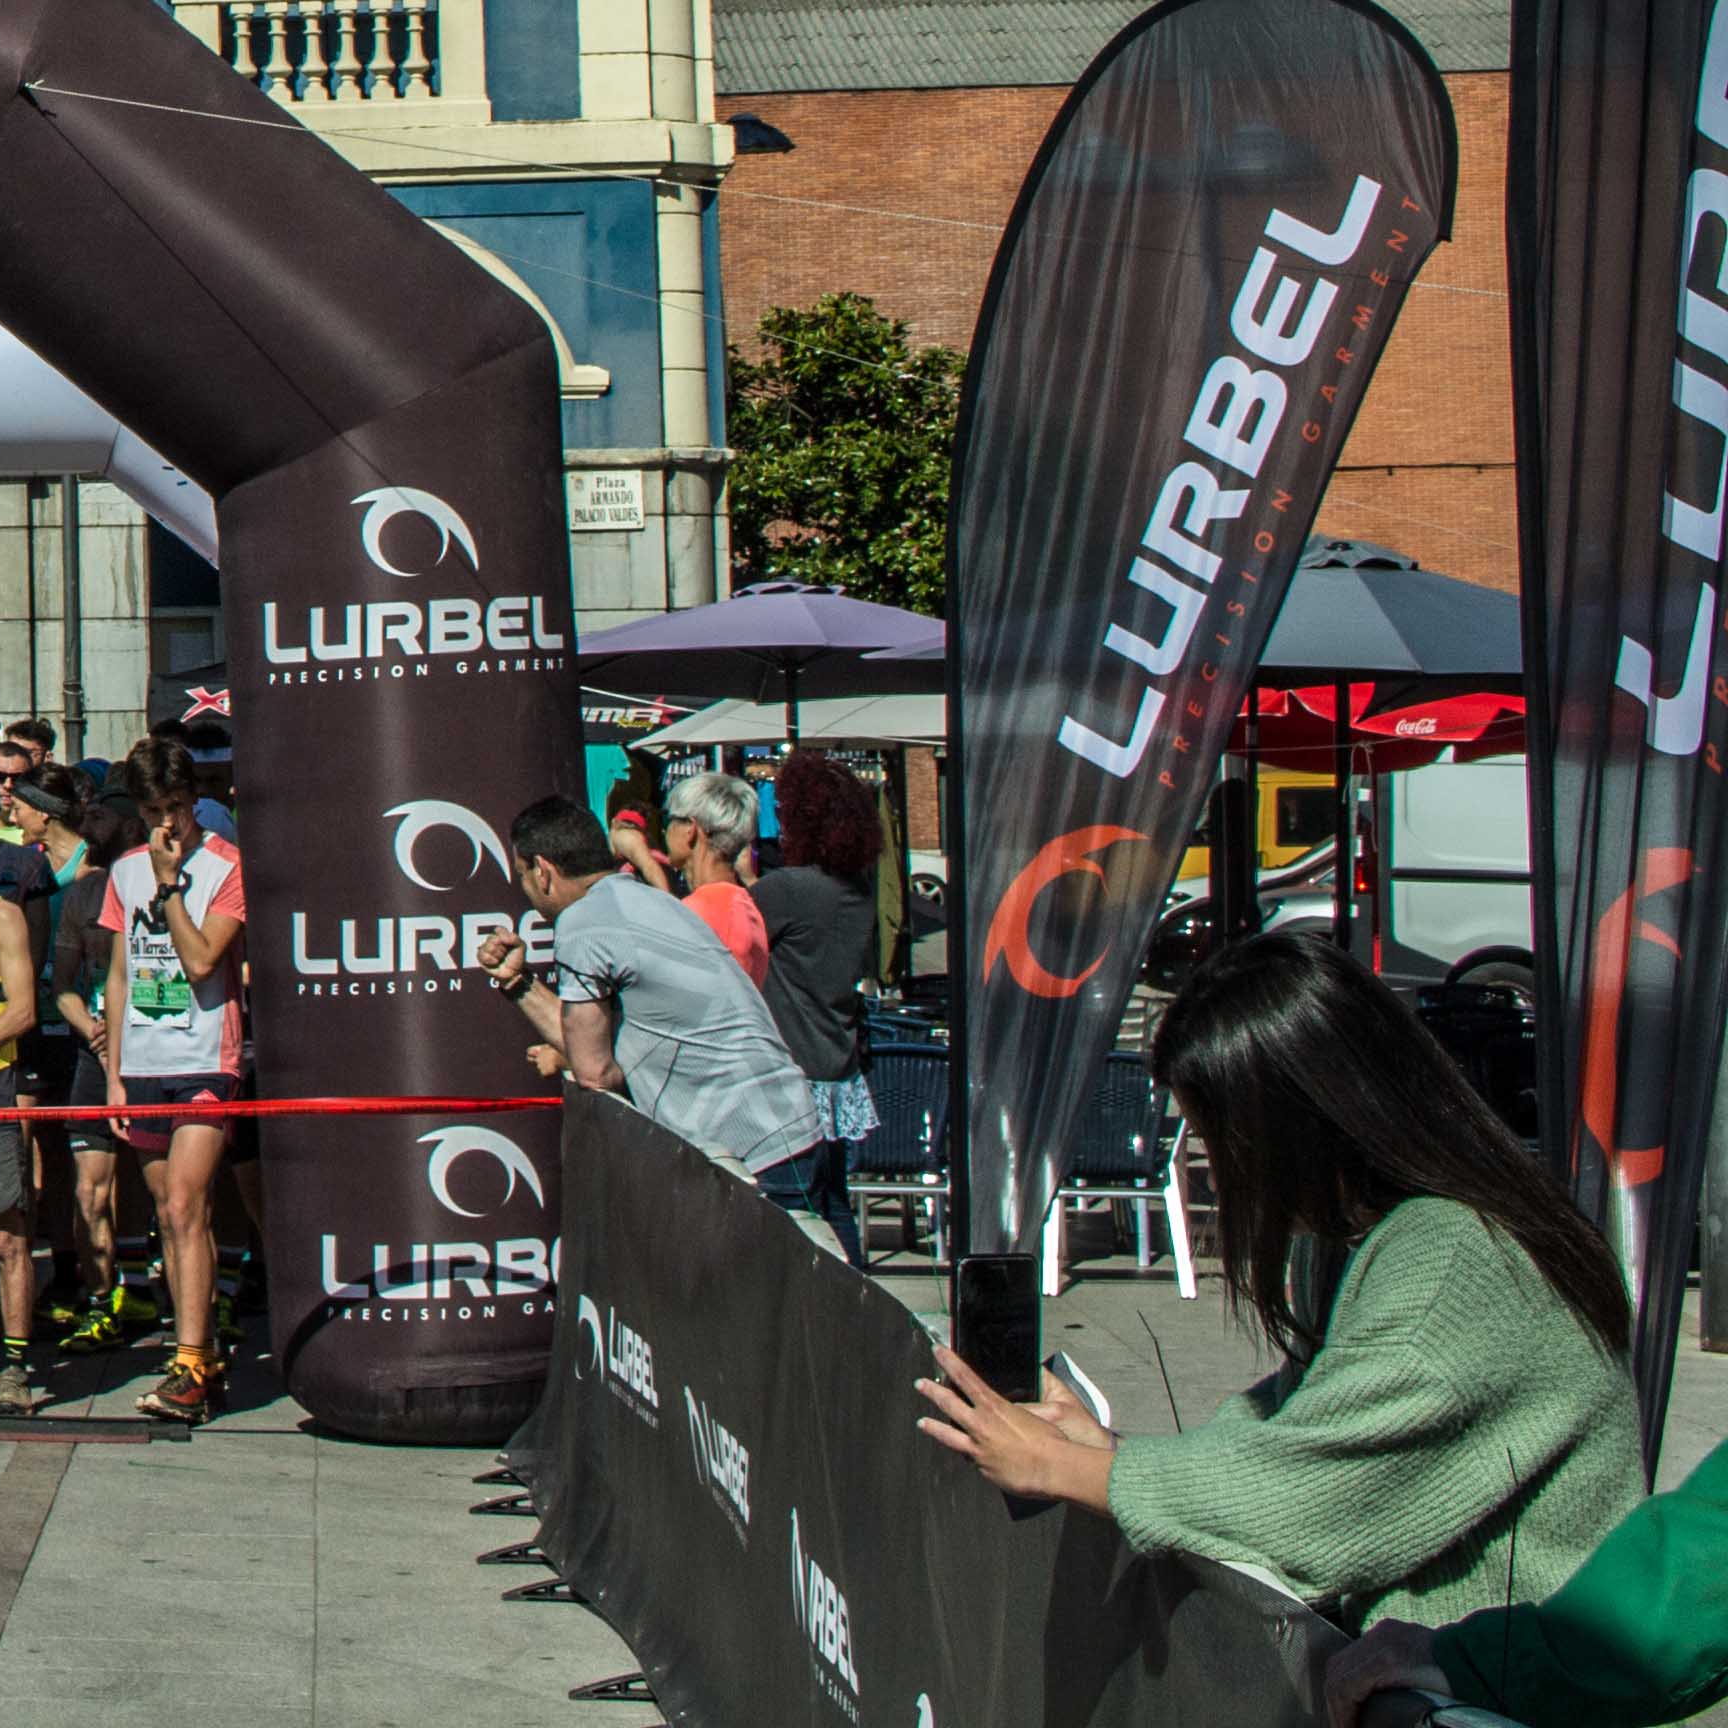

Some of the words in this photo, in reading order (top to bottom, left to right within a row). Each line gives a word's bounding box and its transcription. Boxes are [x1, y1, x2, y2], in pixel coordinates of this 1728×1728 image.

[591, 490, 634, 505] ARMANDO
[596, 476, 626, 488] Plaza
[1057, 175, 1381, 778] LURBEL
[1159, 489, 1293, 789] PRECISION
[1301, 196, 1421, 444] GARMENT
[264, 595, 564, 665] LURBEL
[269, 664, 429, 686] PRECISION
[456, 657, 565, 674] GARMENT
[292, 910, 554, 975] LURBE
[297, 978, 462, 996] PRECISION
[322, 1234, 561, 1300] LURB
[328, 1304, 496, 1320] PRECISION
[609, 1306, 658, 1408] LURBEL
